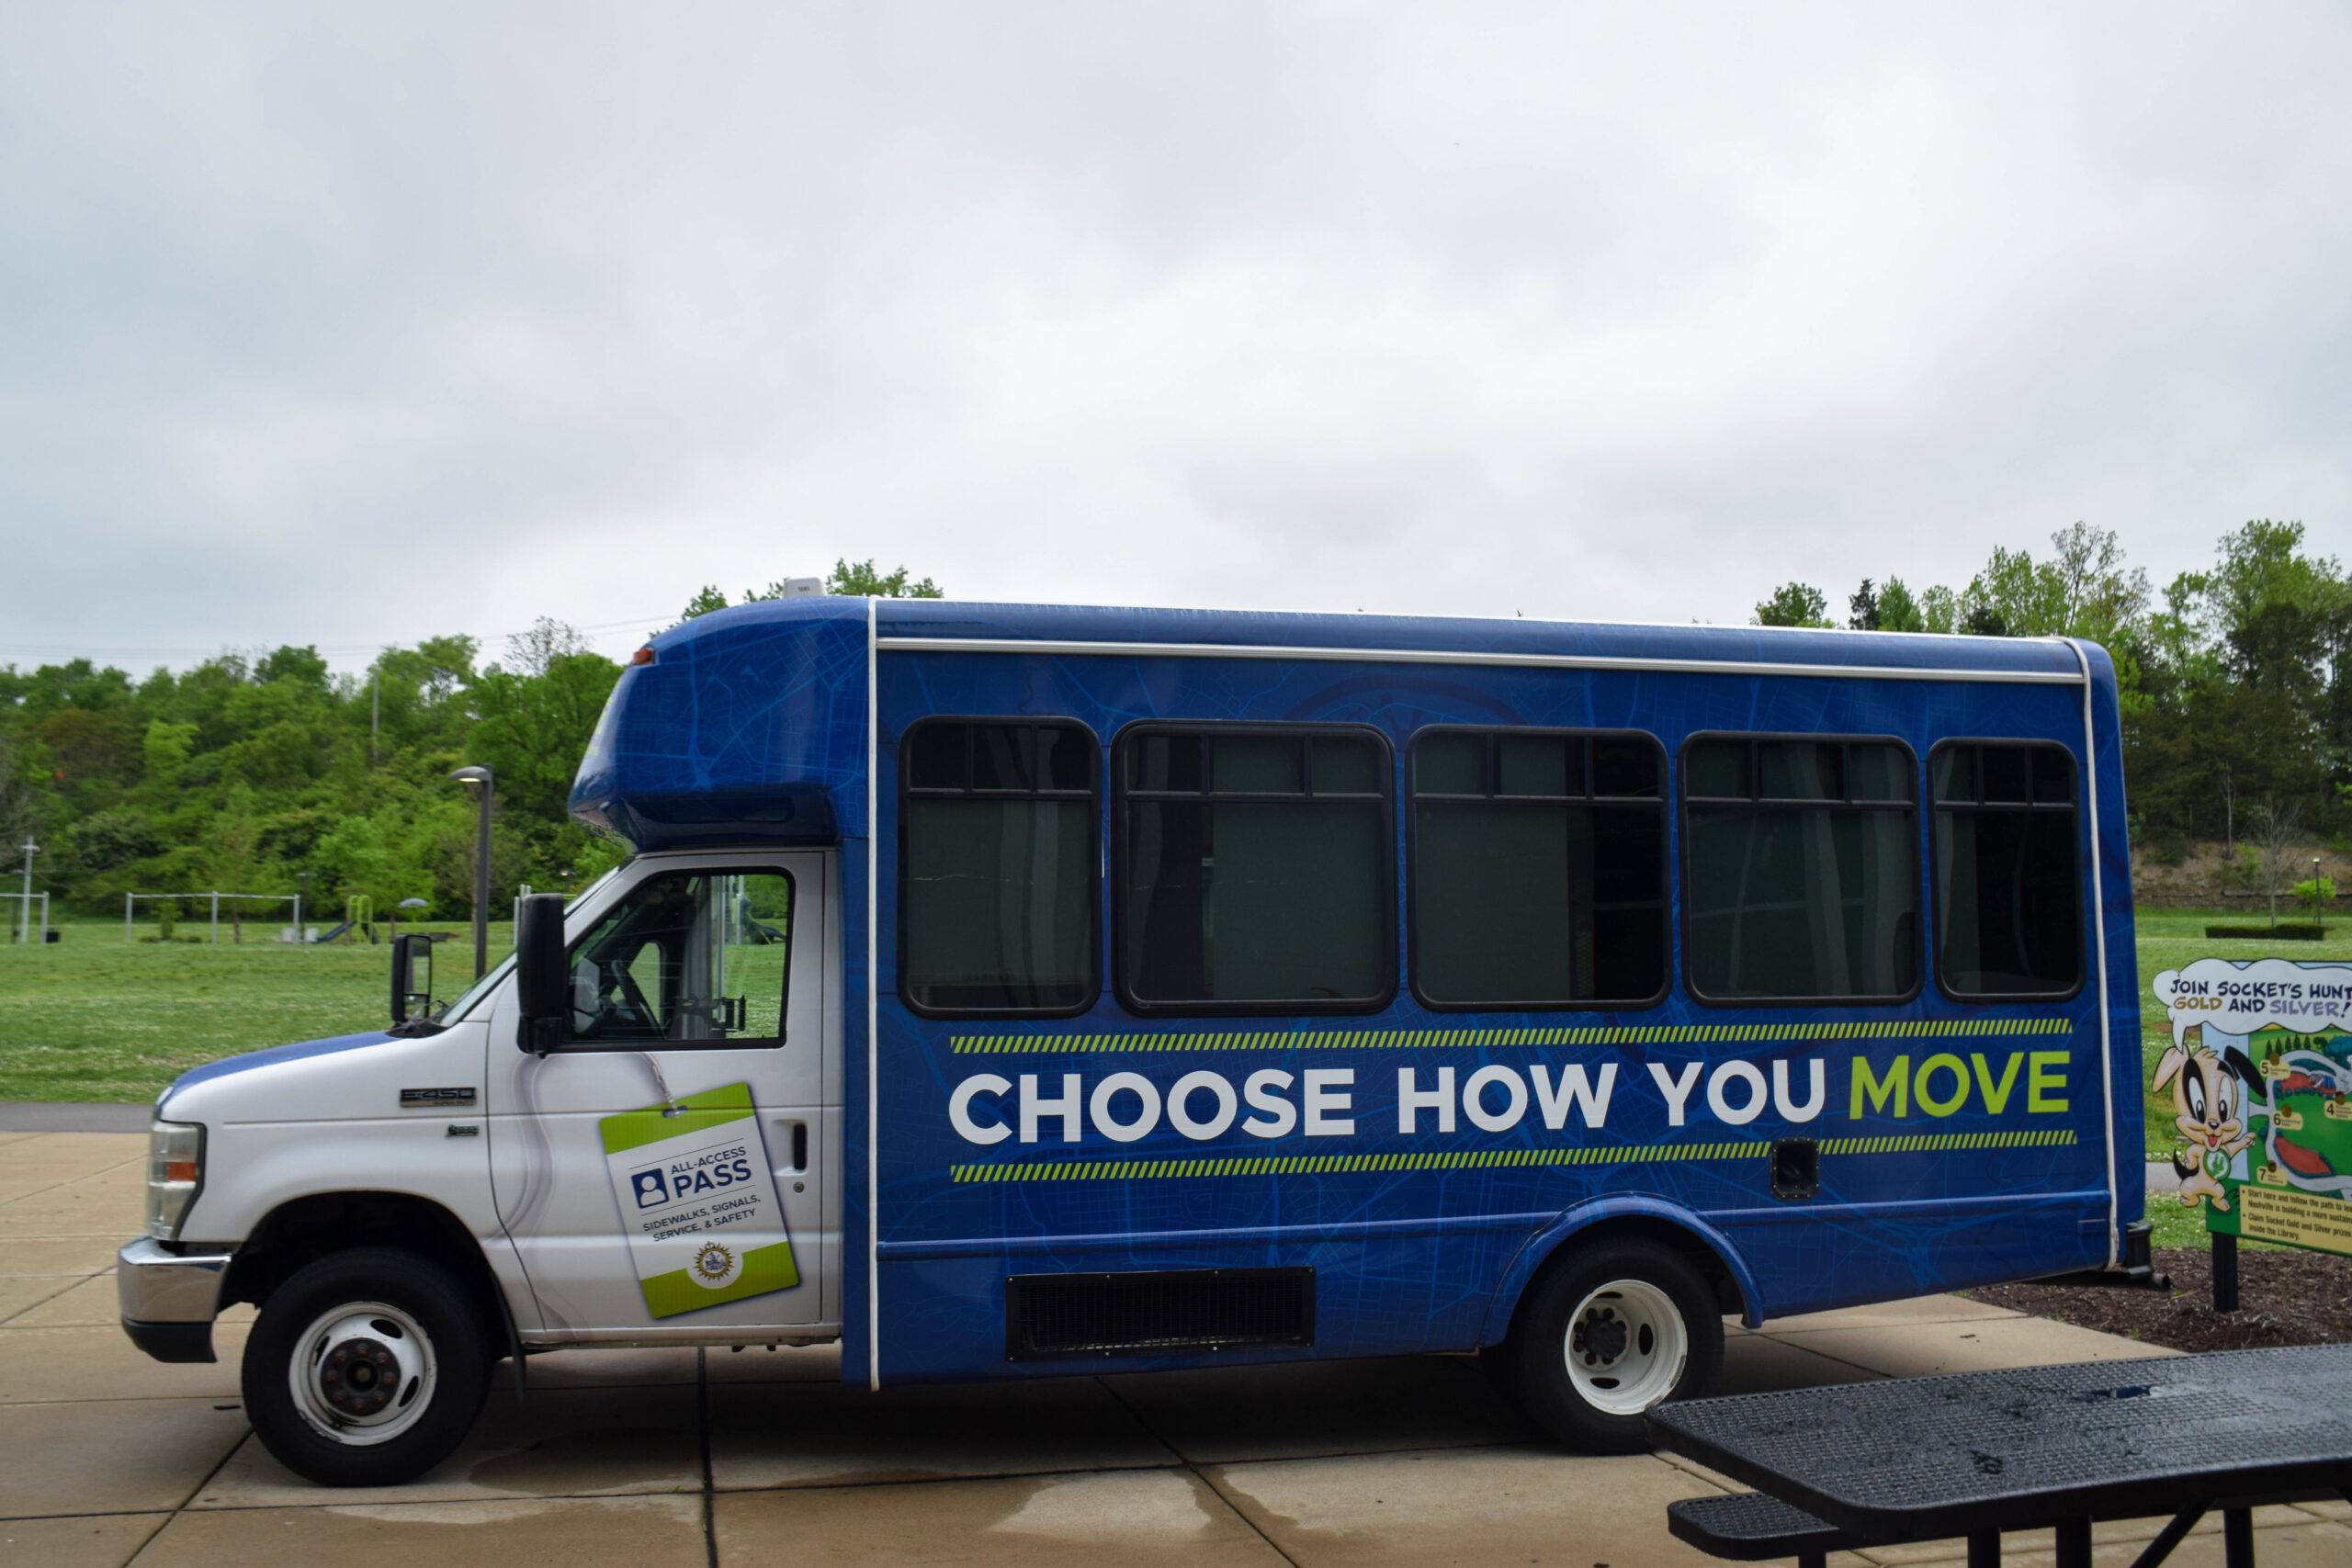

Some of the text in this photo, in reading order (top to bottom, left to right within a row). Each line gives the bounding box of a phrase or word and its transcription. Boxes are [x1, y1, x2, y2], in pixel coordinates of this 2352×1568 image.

[2170, 979, 2209, 995] JOIN
[2217, 980, 2302, 999] SOCKET'S
[2173, 997, 2352, 1019] GOLD AND SILVER!
[2261, 1062, 2269, 1075] 5
[948, 1050, 2071, 1145] CHOOSE HOW YOU MOVE
[2273, 1113, 2281, 1126] 6
[2326, 1103, 2335, 1115] 4
[671, 1146, 747, 1175] ALL-ACCESS
[673, 1158, 752, 1199] PASS
[2258, 1168, 2267, 1181] 7
[2278, 1194, 2289, 1202] and
[2309, 1198, 2319, 1207] the
[642, 1194, 762, 1232] SIDEWALKS, SIGNALS,
[652, 1208, 756, 1242] SERVICE, & SAFETY
